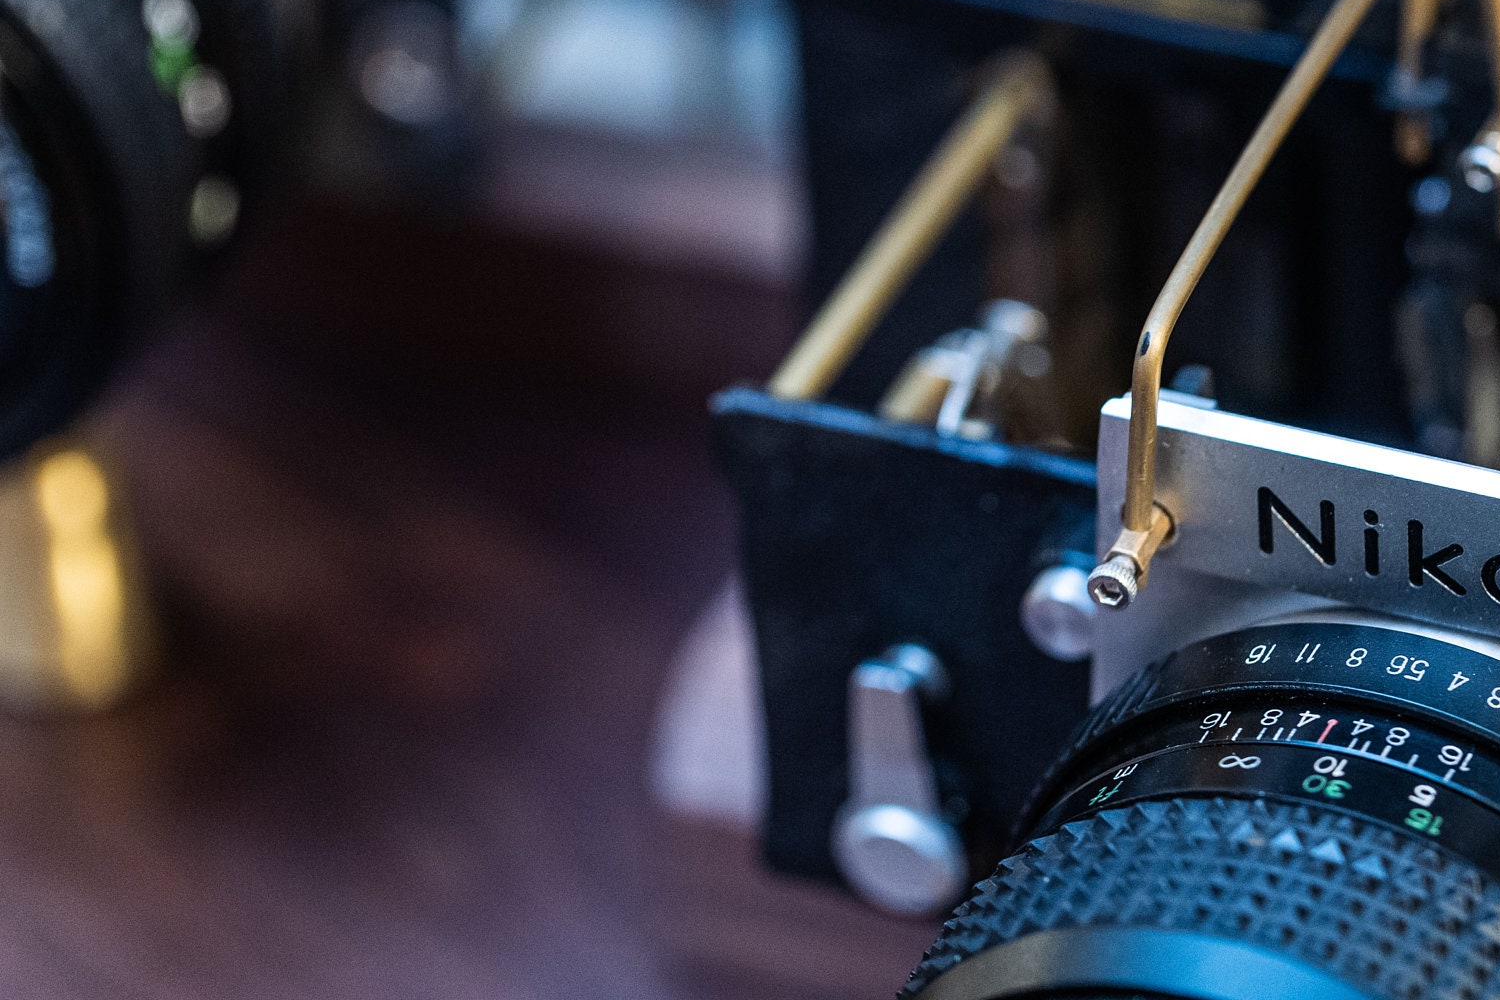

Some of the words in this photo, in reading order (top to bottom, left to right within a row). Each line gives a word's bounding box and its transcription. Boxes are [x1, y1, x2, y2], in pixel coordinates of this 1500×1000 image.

[1245, 643, 1277, 665] 16
[1294, 643, 1321, 663] 11
[1345, 647, 1368, 668] 8
[1447, 671, 1470, 692] 4
[1199, 710, 1232, 730] 16
[1260, 708, 1284, 726] 8
[1296, 710, 1321, 728] 4
[1350, 718, 1375, 736] 4
[1385, 727, 1411, 746] 8
[1313, 756, 1348, 778] 10
[1437, 745, 1474, 772] 16
[1302, 774, 1352, 798] 30
[1407, 784, 1438, 808] 5
[1404, 808, 1444, 836] 15
